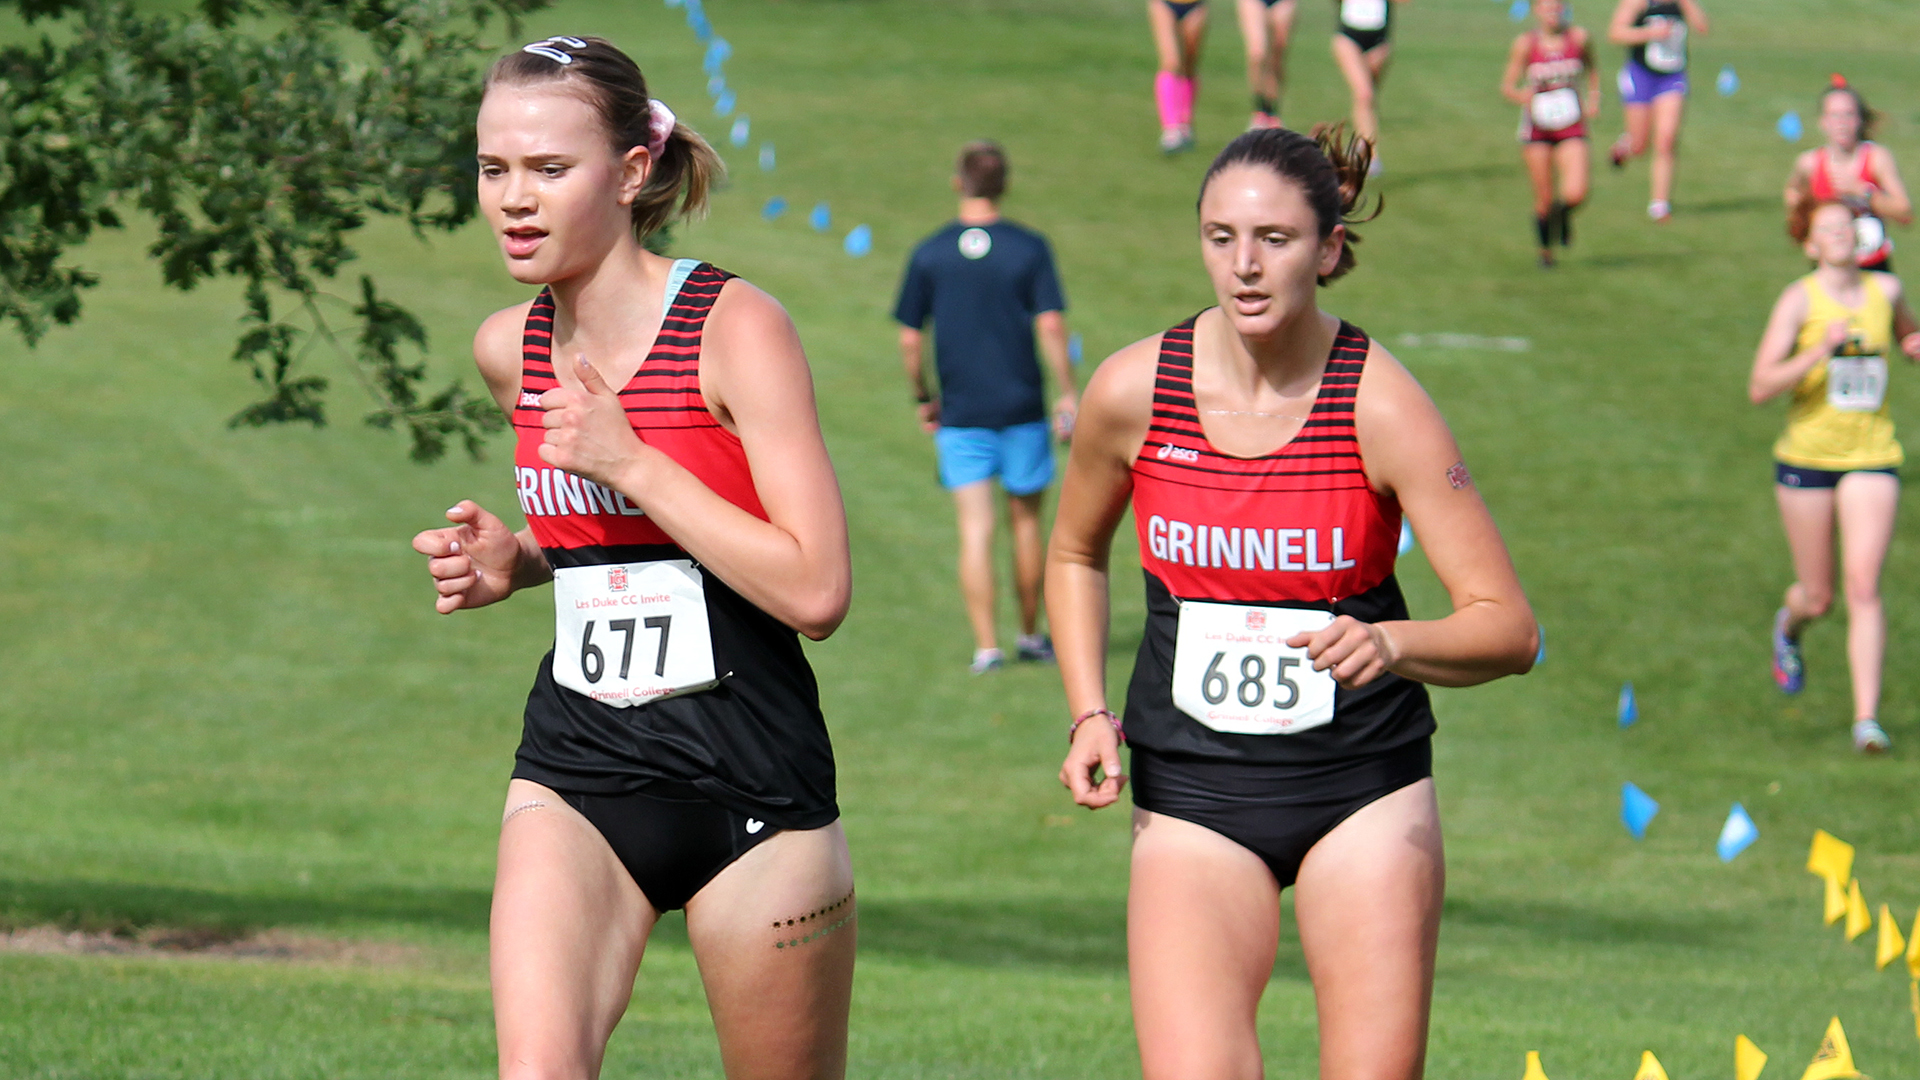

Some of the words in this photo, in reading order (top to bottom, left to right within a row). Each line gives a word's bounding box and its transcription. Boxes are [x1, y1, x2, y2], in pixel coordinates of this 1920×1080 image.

[1148, 514, 1356, 572] GRINNELL
[575, 599, 590, 609] Les
[592, 597, 618, 608] Duke
[621, 595, 638, 605] CC
[640, 592, 671, 604] Invite
[580, 614, 672, 684] 677
[1257, 634, 1274, 644] CC
[589, 687, 629, 700] Grinnell
[633, 685, 675, 696] College
[1201, 650, 1301, 711] 685
